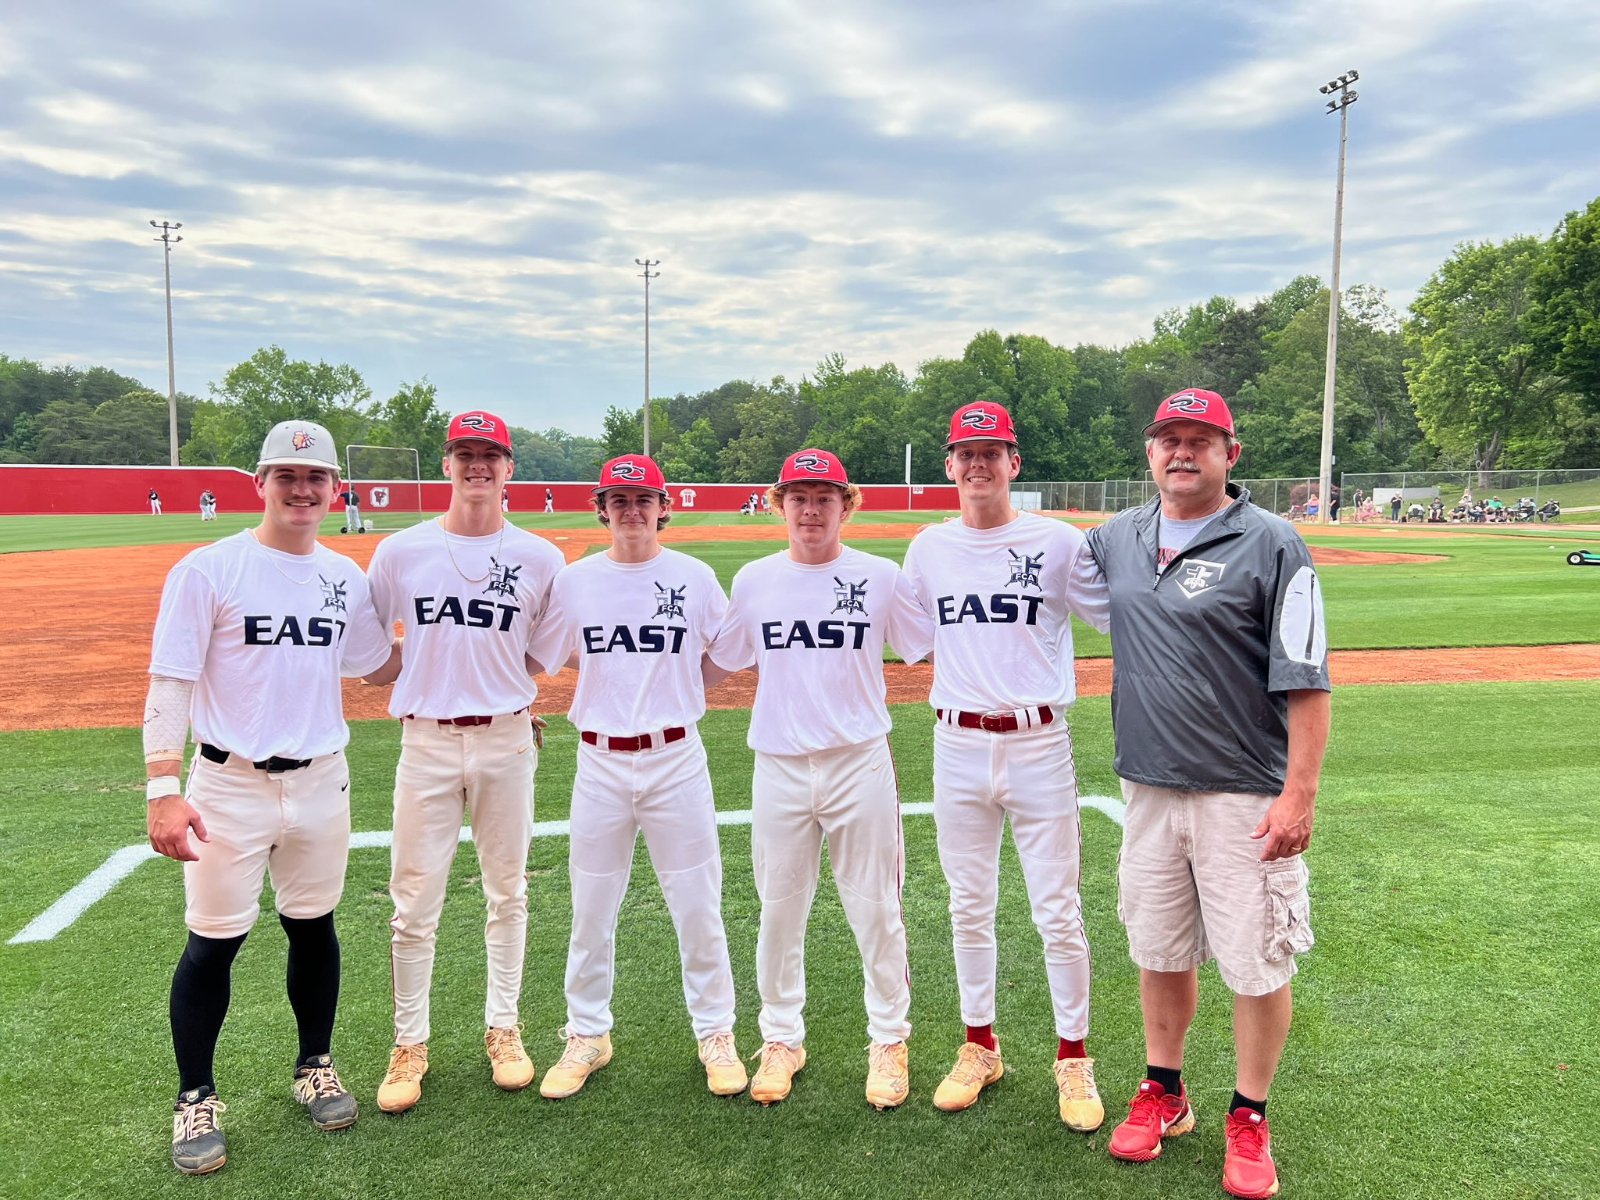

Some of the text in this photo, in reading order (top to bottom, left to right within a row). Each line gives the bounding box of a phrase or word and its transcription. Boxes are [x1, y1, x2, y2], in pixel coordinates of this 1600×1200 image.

[1167, 392, 1208, 414] SC
[460, 414, 495, 432] SC
[961, 408, 997, 430] SC
[611, 461, 645, 481] SC
[794, 453, 829, 473] SC
[493, 581, 510, 591] FCA
[1015, 573, 1034, 581] FCA
[328, 598, 343, 607] FCA
[661, 604, 680, 613] FCA
[841, 600, 860, 608] FCA
[937, 593, 1044, 626] EAST
[414, 596, 520, 632] EAST
[583, 624, 687, 654] EAST
[761, 620, 870, 650] EAST
